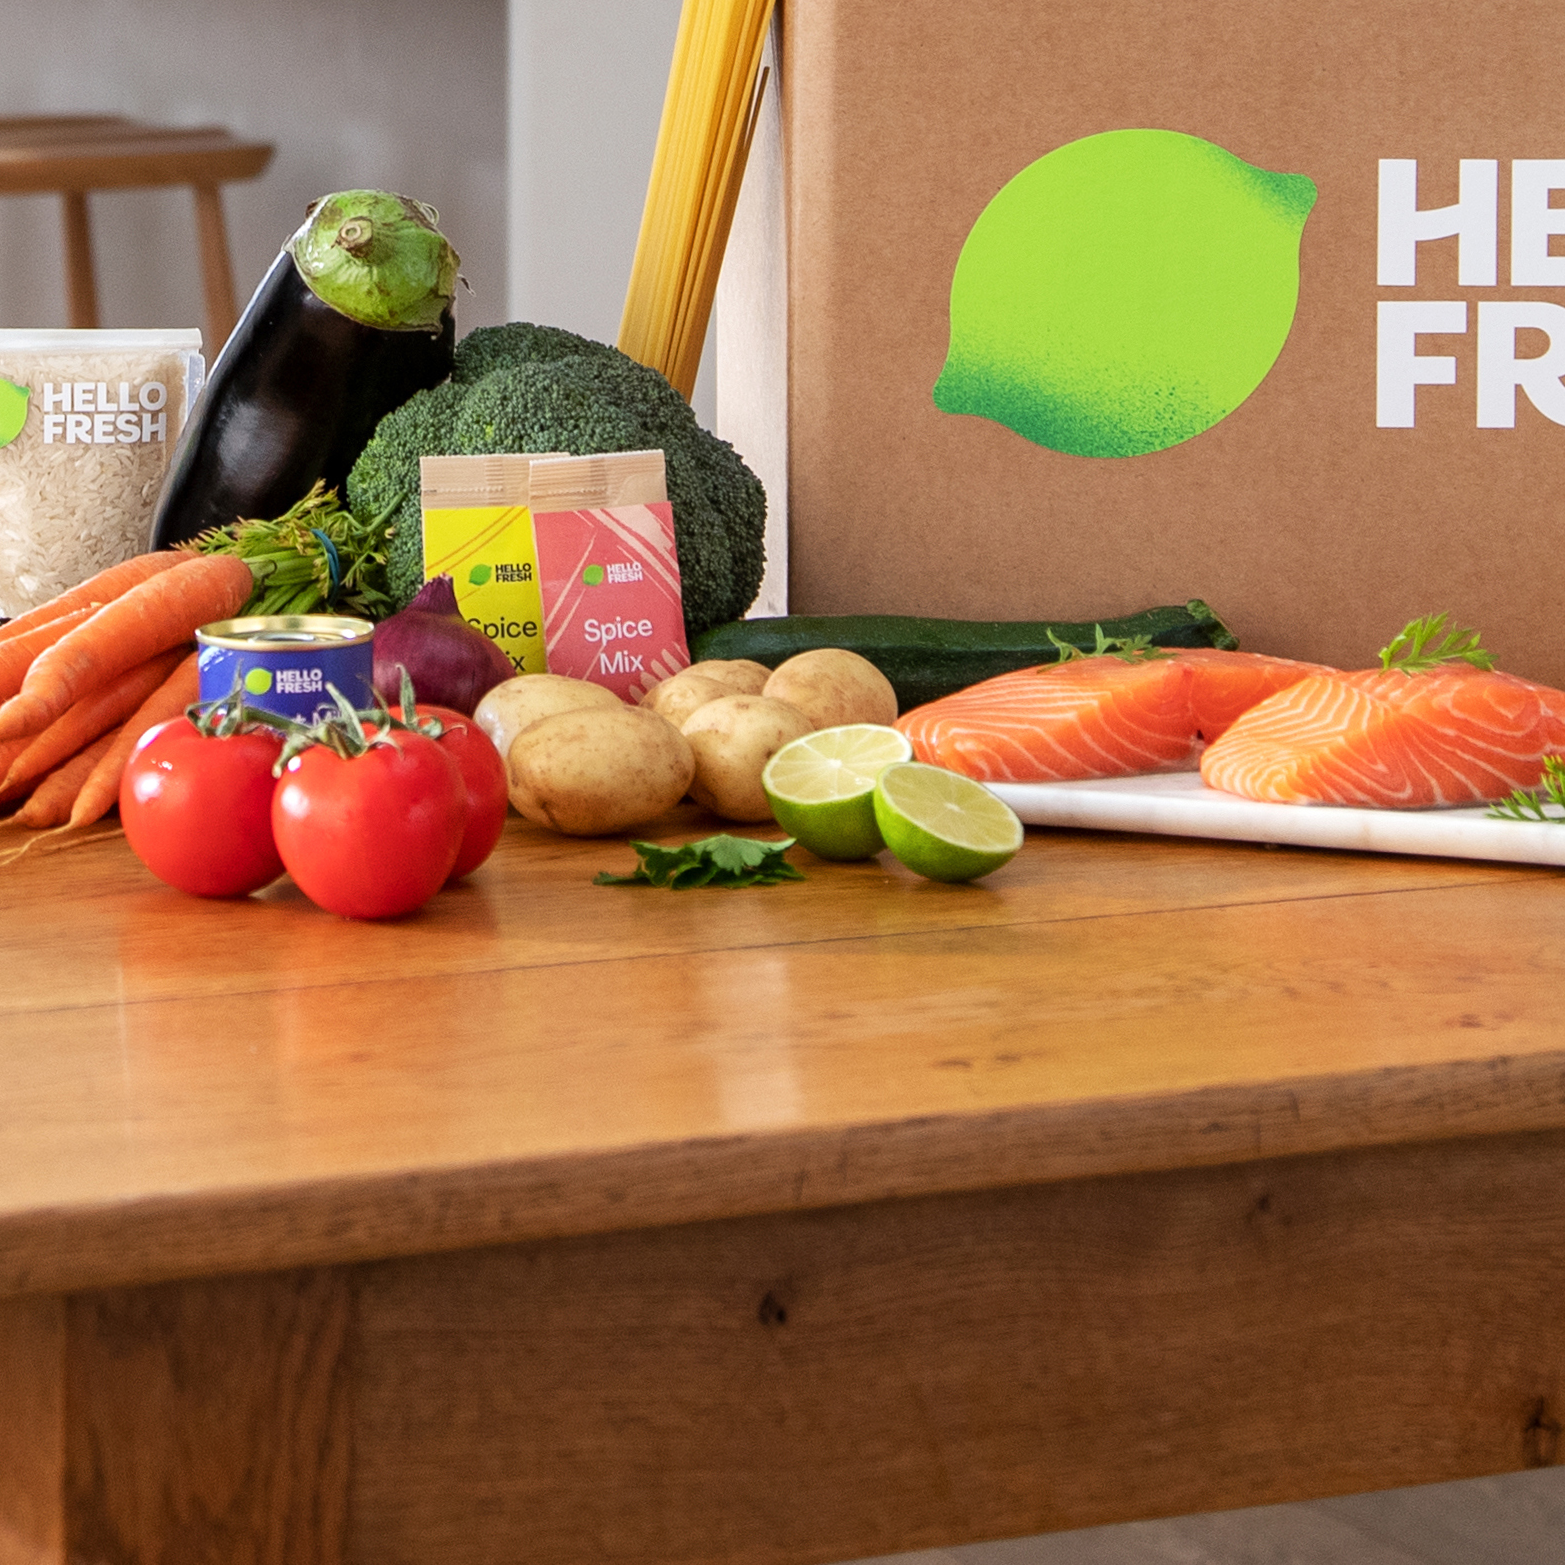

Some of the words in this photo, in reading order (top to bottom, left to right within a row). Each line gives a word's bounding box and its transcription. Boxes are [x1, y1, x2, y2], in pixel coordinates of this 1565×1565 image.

[42, 381, 167, 412] HELLO
[42, 412, 167, 444] FRESH
[495, 563, 532, 574] HELLO
[607, 561, 642, 574] HELLO
[496, 572, 532, 583] FRESH
[608, 571, 643, 584] FRESH
[583, 616, 653, 647] Spice
[599, 650, 645, 675] Mix
[276, 668, 323, 683] HELLO
[276, 680, 323, 694] FRESH
